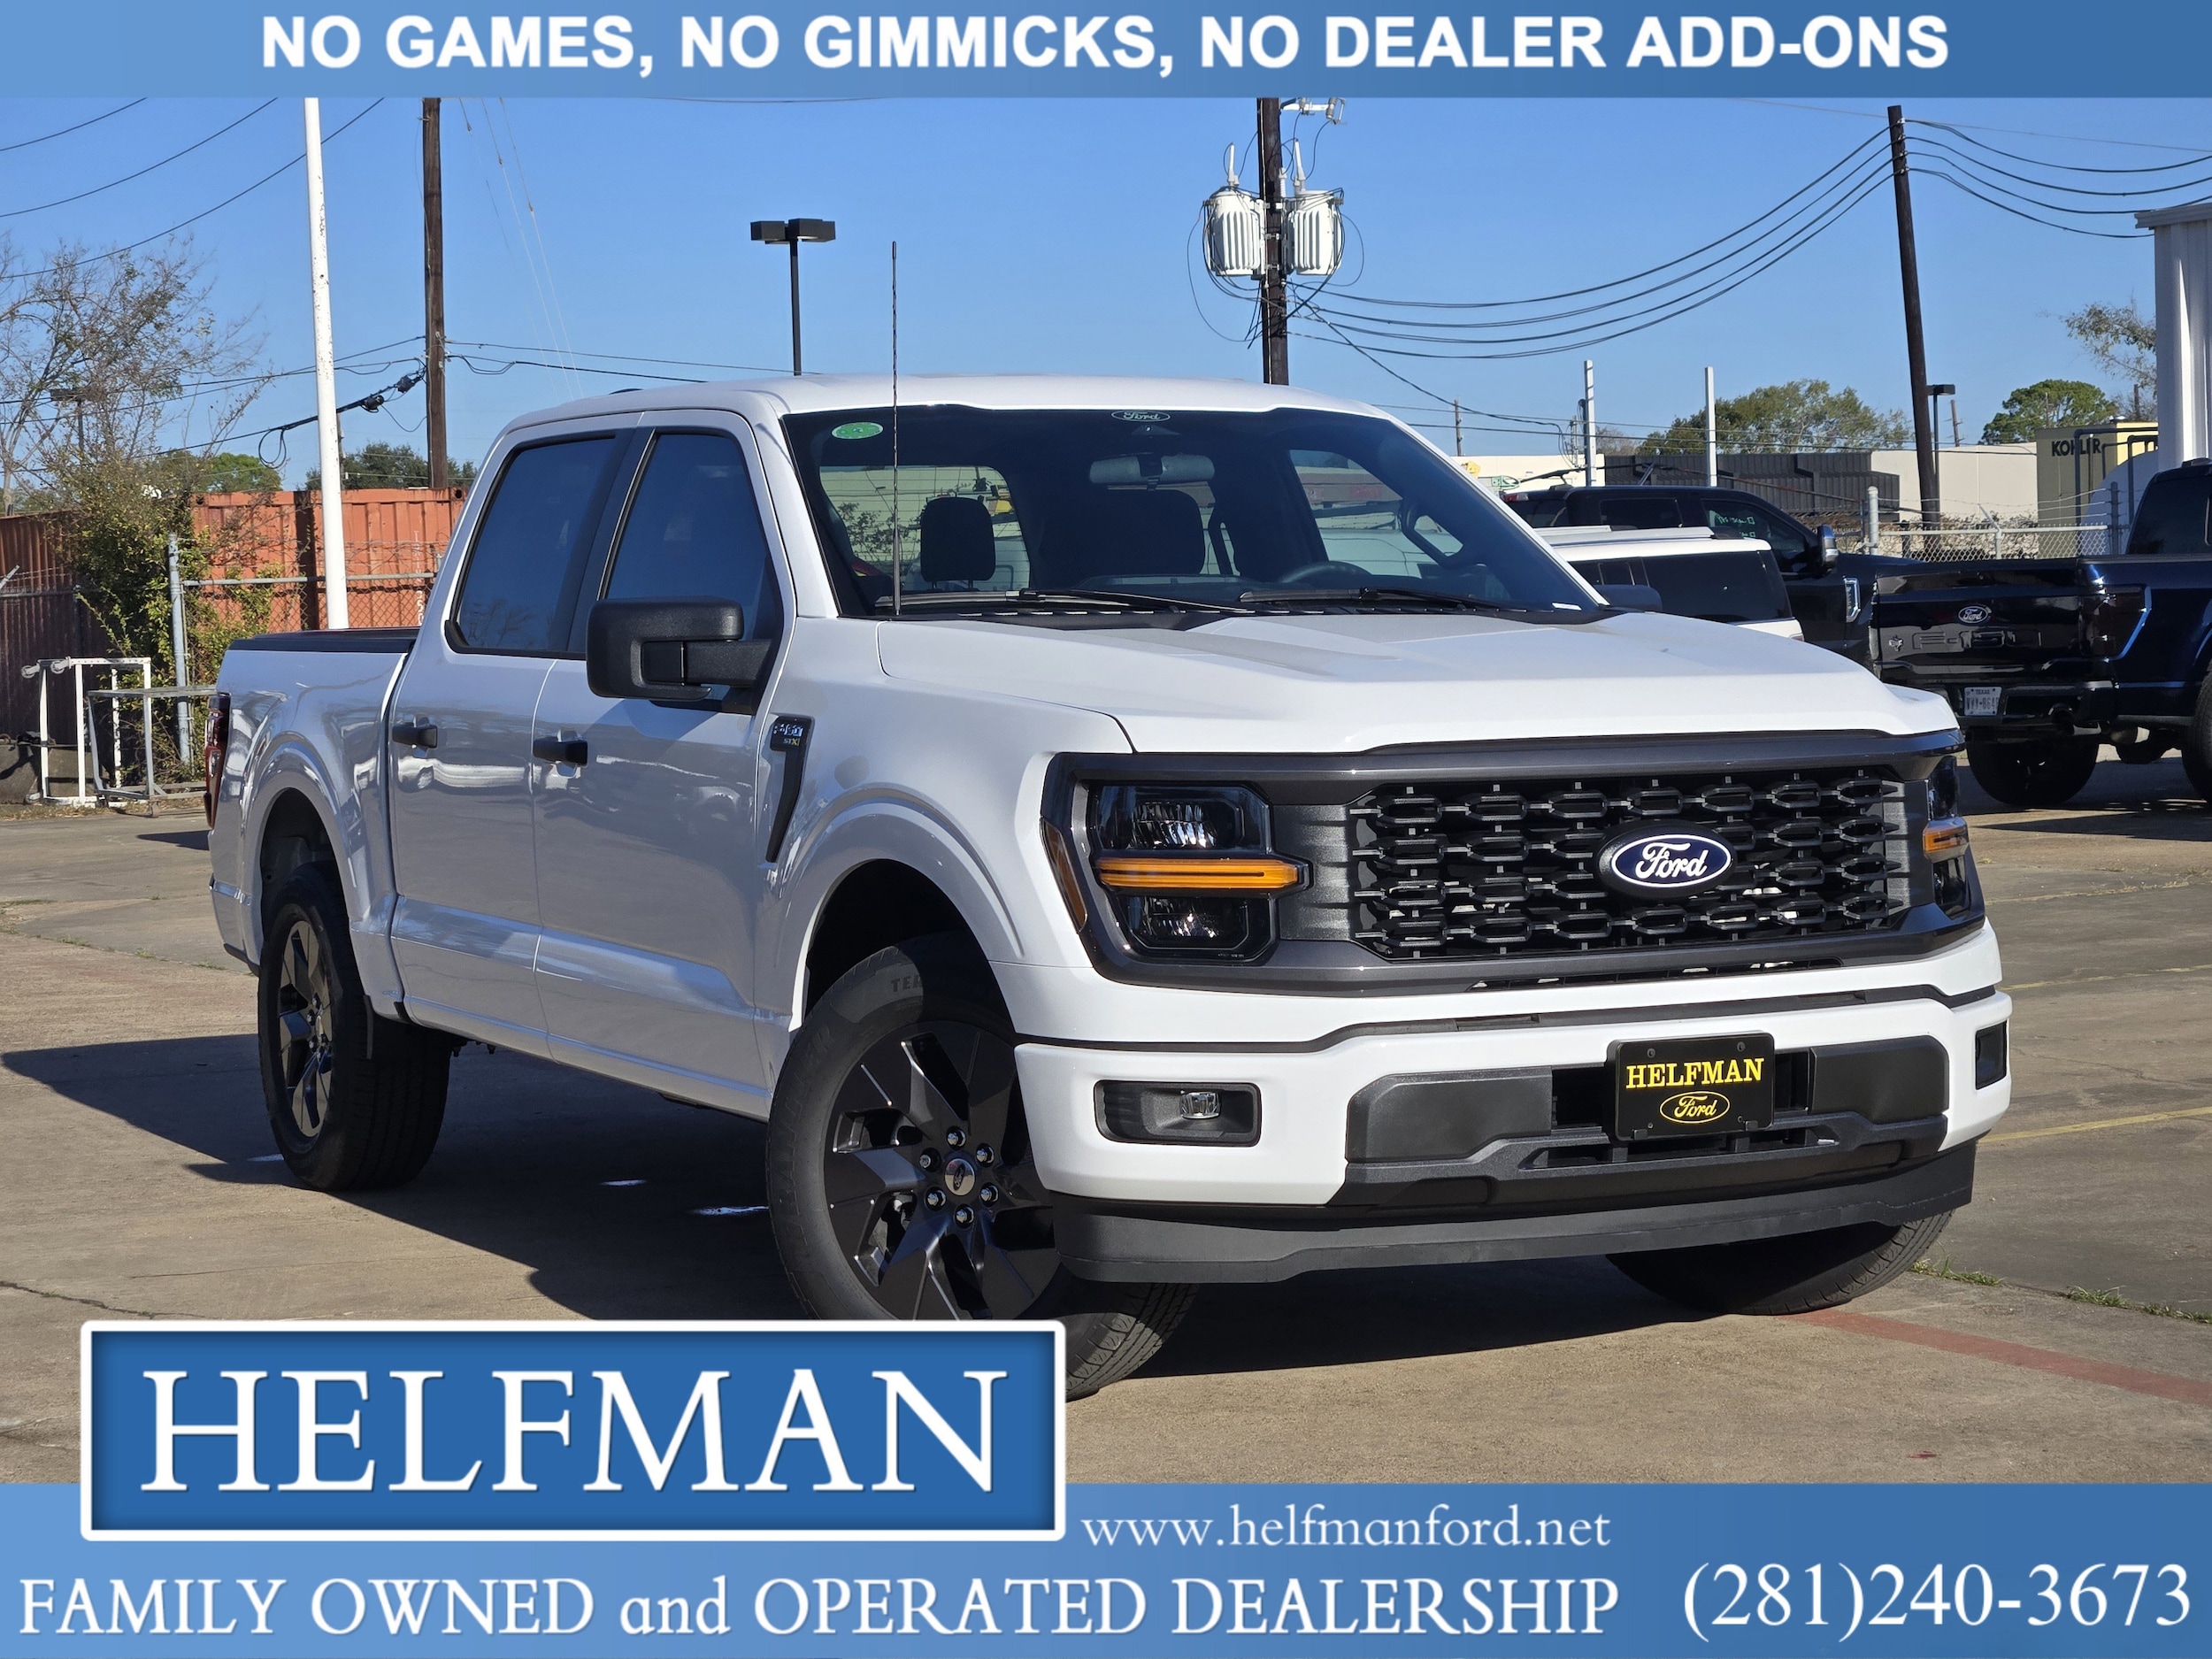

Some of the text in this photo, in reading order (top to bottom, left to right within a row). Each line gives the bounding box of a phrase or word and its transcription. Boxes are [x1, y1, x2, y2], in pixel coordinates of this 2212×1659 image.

[1123, 411, 1161, 420] Ford
[1962, 608, 1984, 621] Ford
[1634, 841, 1711, 880] Ford
[1625, 1056, 1765, 1090] HELFMAN
[1673, 1094, 1718, 1118] Ford
